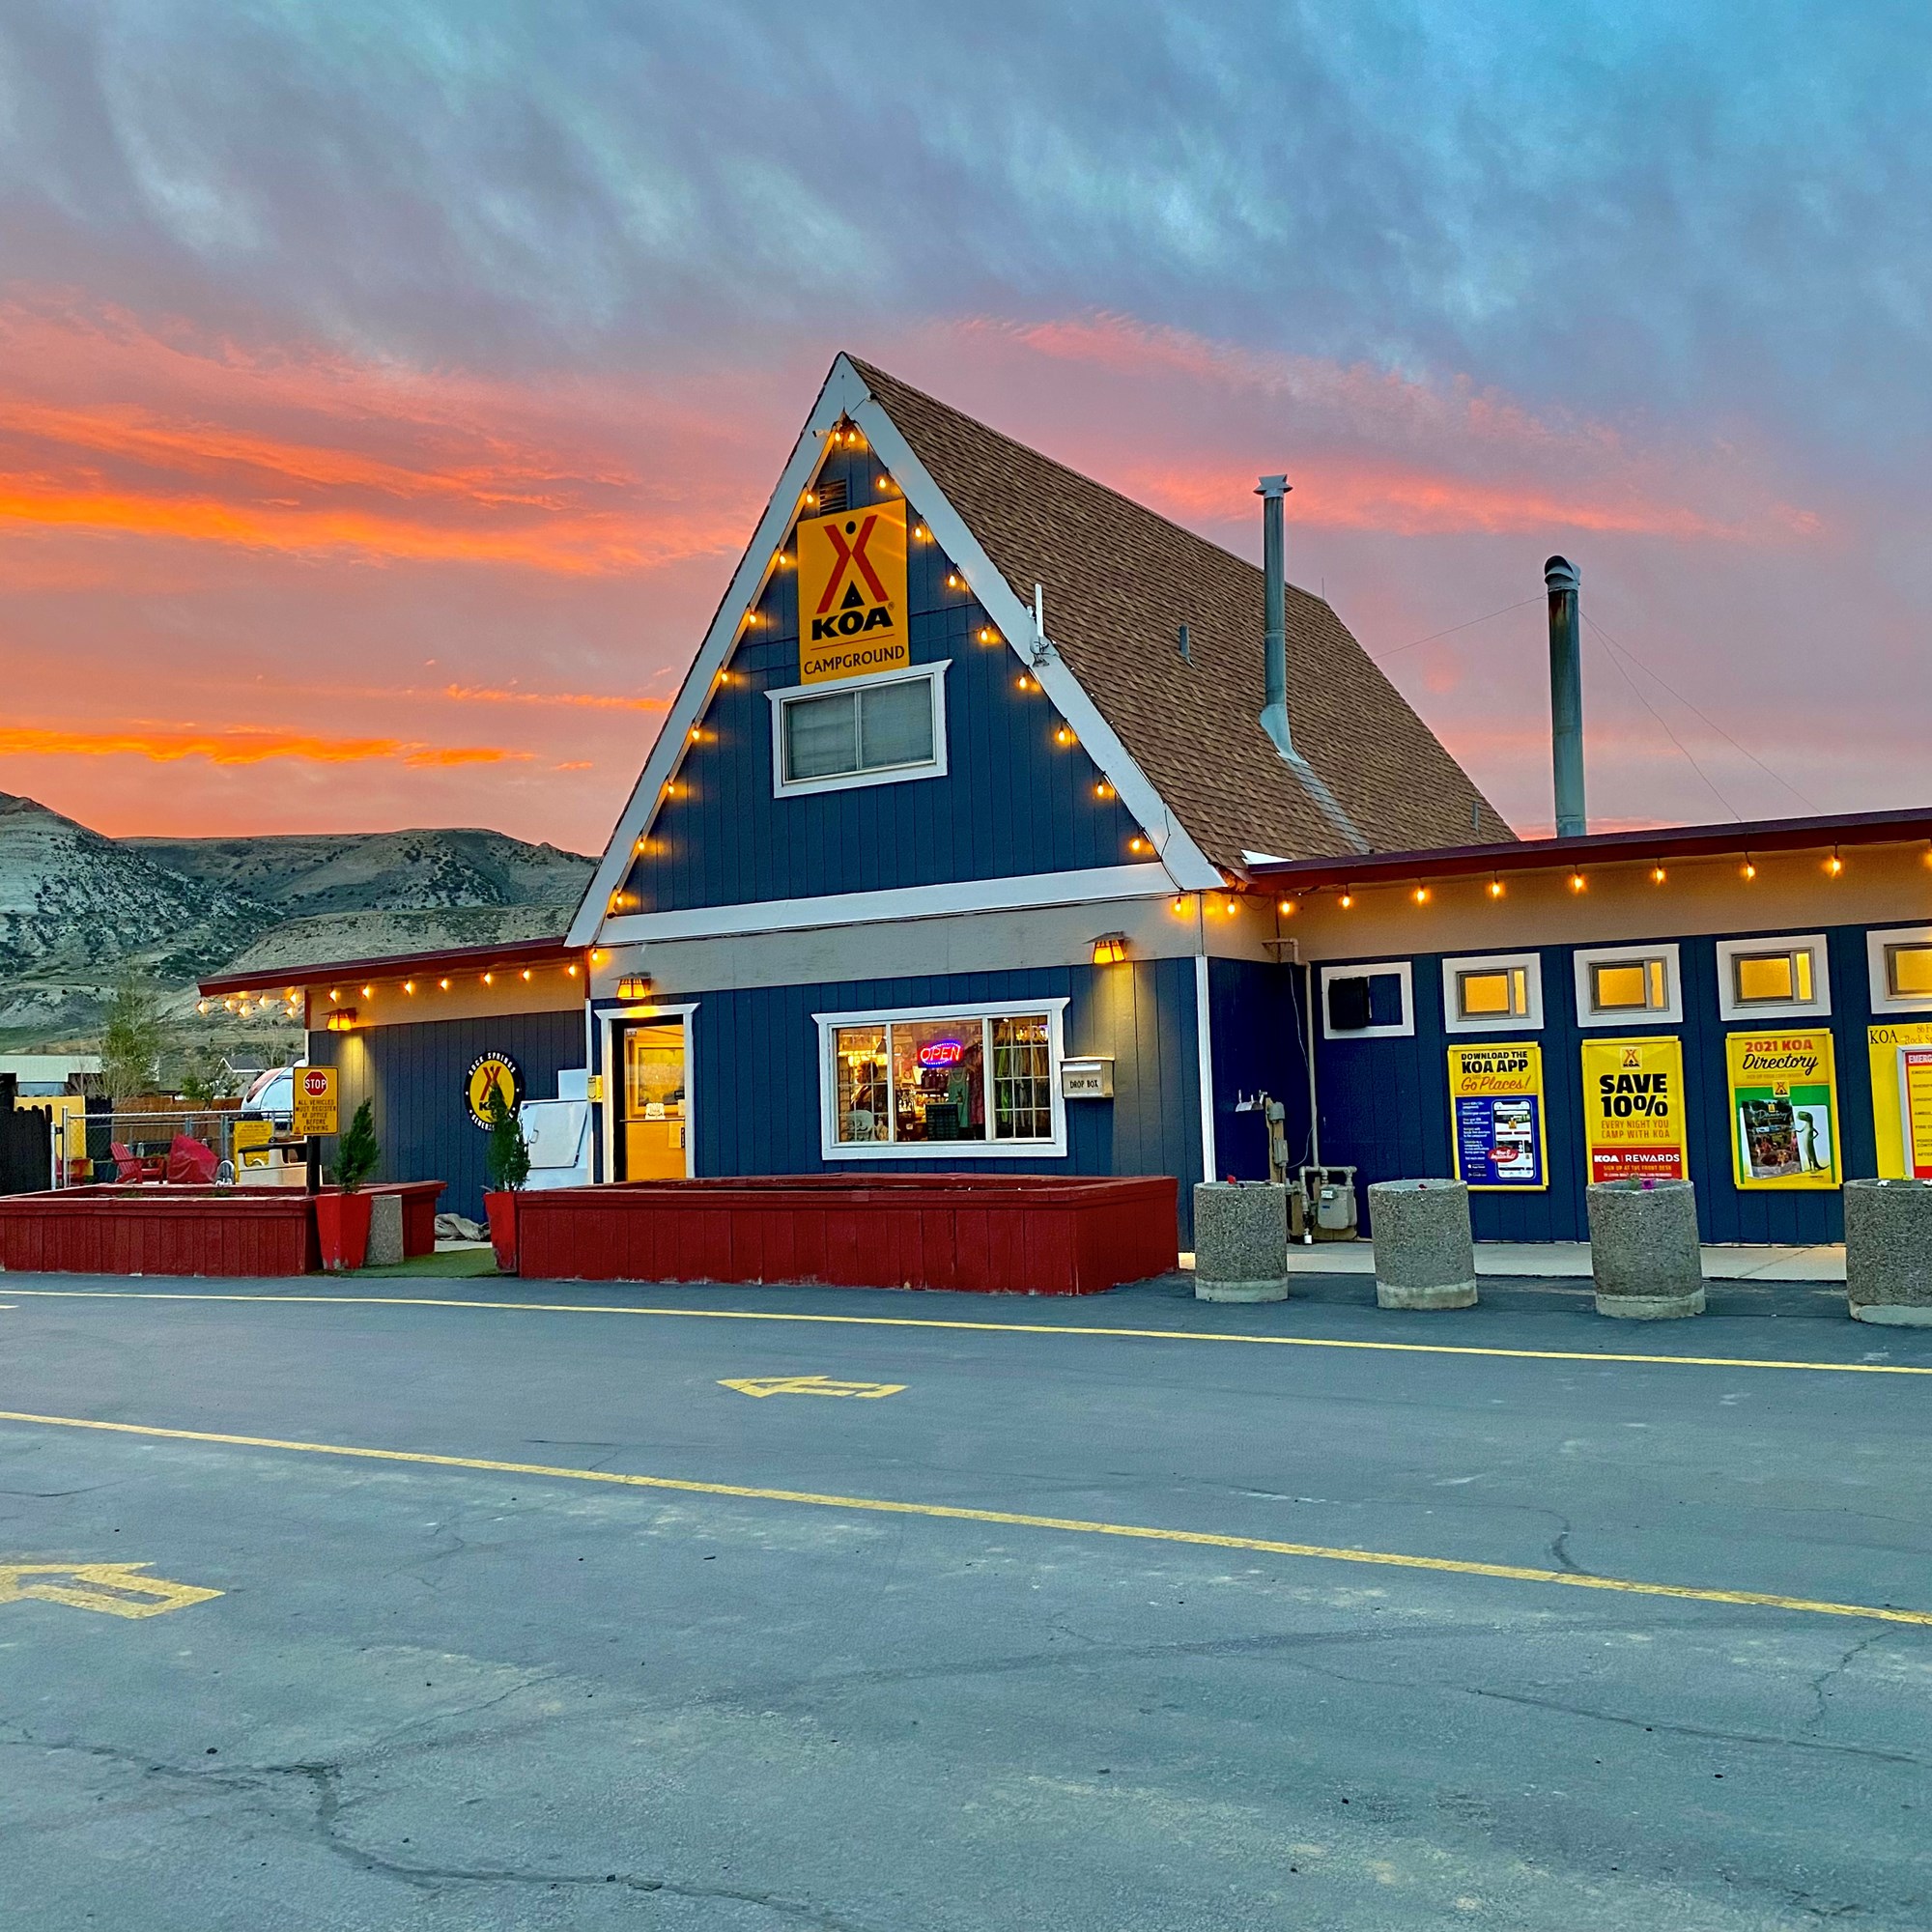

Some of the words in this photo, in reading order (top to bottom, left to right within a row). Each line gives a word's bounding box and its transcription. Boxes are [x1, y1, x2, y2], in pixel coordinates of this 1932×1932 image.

[811, 606, 894, 641] KOA
[804, 645, 905, 675] CAMPGROUND
[1869, 1030, 1898, 1043] KOA
[1905, 1036, 1923, 1044] Rock
[1746, 1041, 1777, 1052] 2021
[1782, 1039, 1813, 1051] KOA
[921, 1046, 960, 1061] OPEN
[468, 1056, 484, 1076] ROCK
[487, 1052, 516, 1073] SPRINGS
[1463, 1061, 1493, 1073] KOA
[1496, 1059, 1528, 1072] APP
[1743, 1053, 1819, 1076] Directory
[305, 1079, 327, 1089] STOP
[1070, 1080, 1084, 1089] DROP
[1087, 1079, 1098, 1088] BOX
[1462, 1076, 1477, 1091] Go
[1480, 1074, 1531, 1090] Places!
[1600, 1073, 1667, 1094] SAVE
[1627, 1120, 1650, 1128] NIGHT
[1654, 1120, 1668, 1128] YOU
